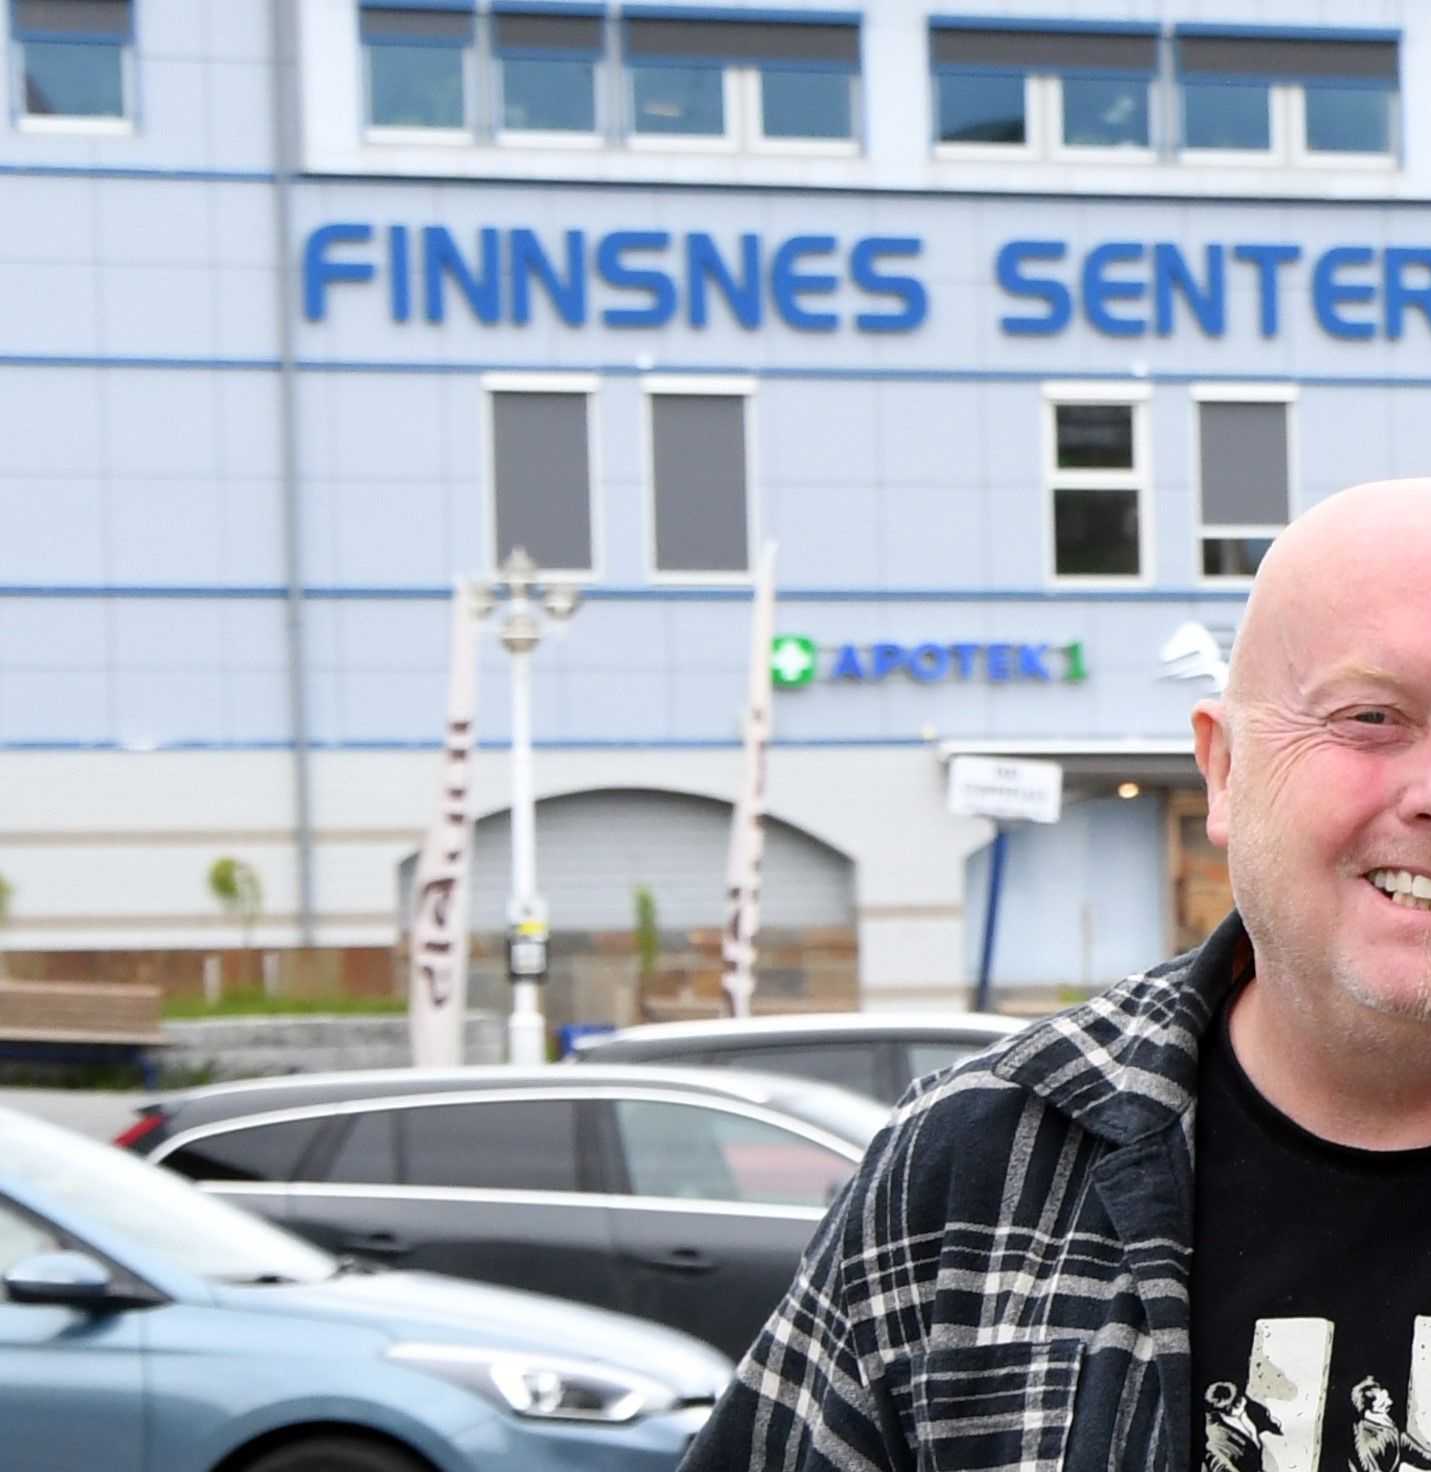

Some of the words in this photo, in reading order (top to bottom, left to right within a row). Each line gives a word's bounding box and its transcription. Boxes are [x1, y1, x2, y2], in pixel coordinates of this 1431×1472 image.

[304, 223, 927, 331] FINNSNES
[834, 642, 1049, 681] APOTEK
[1064, 641, 1087, 681] 1
